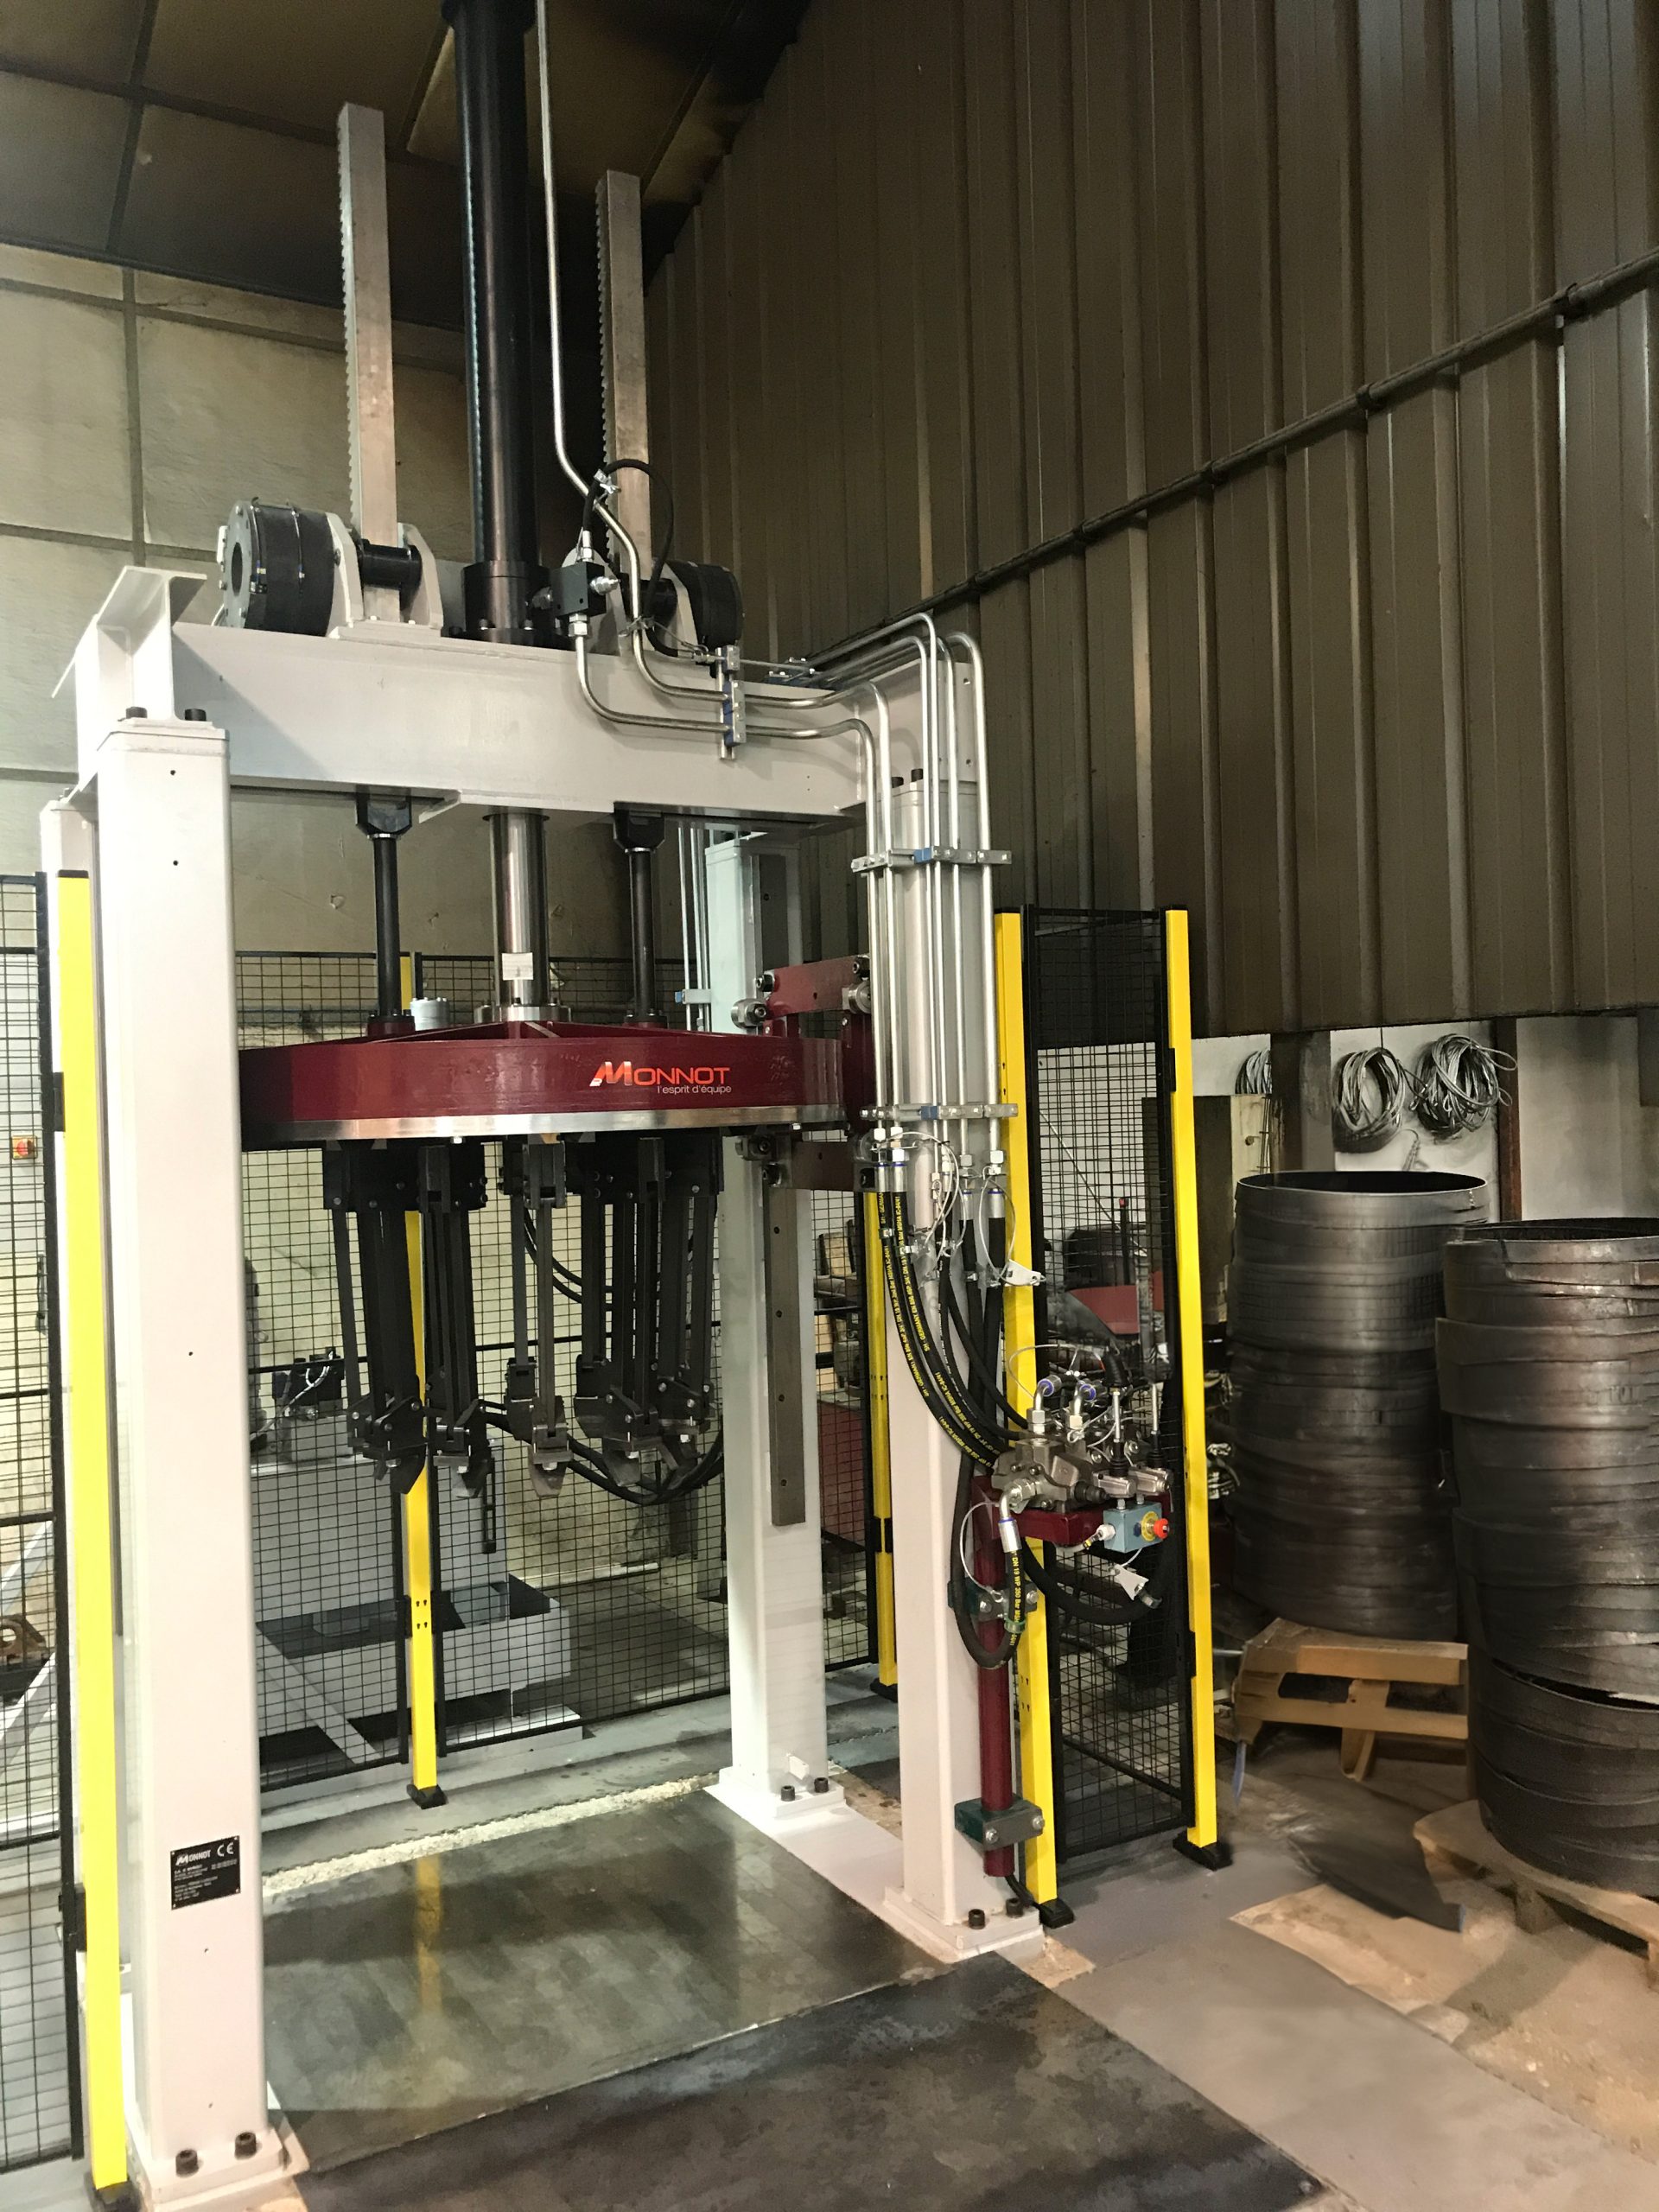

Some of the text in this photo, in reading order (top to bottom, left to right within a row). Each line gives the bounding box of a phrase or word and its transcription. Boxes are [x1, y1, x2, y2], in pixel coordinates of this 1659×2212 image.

[589, 1061, 731, 1087] MONNOT
[657, 1085, 732, 1095] l'esprit d'équipe
[175, 1850, 211, 1866] MONNOT
